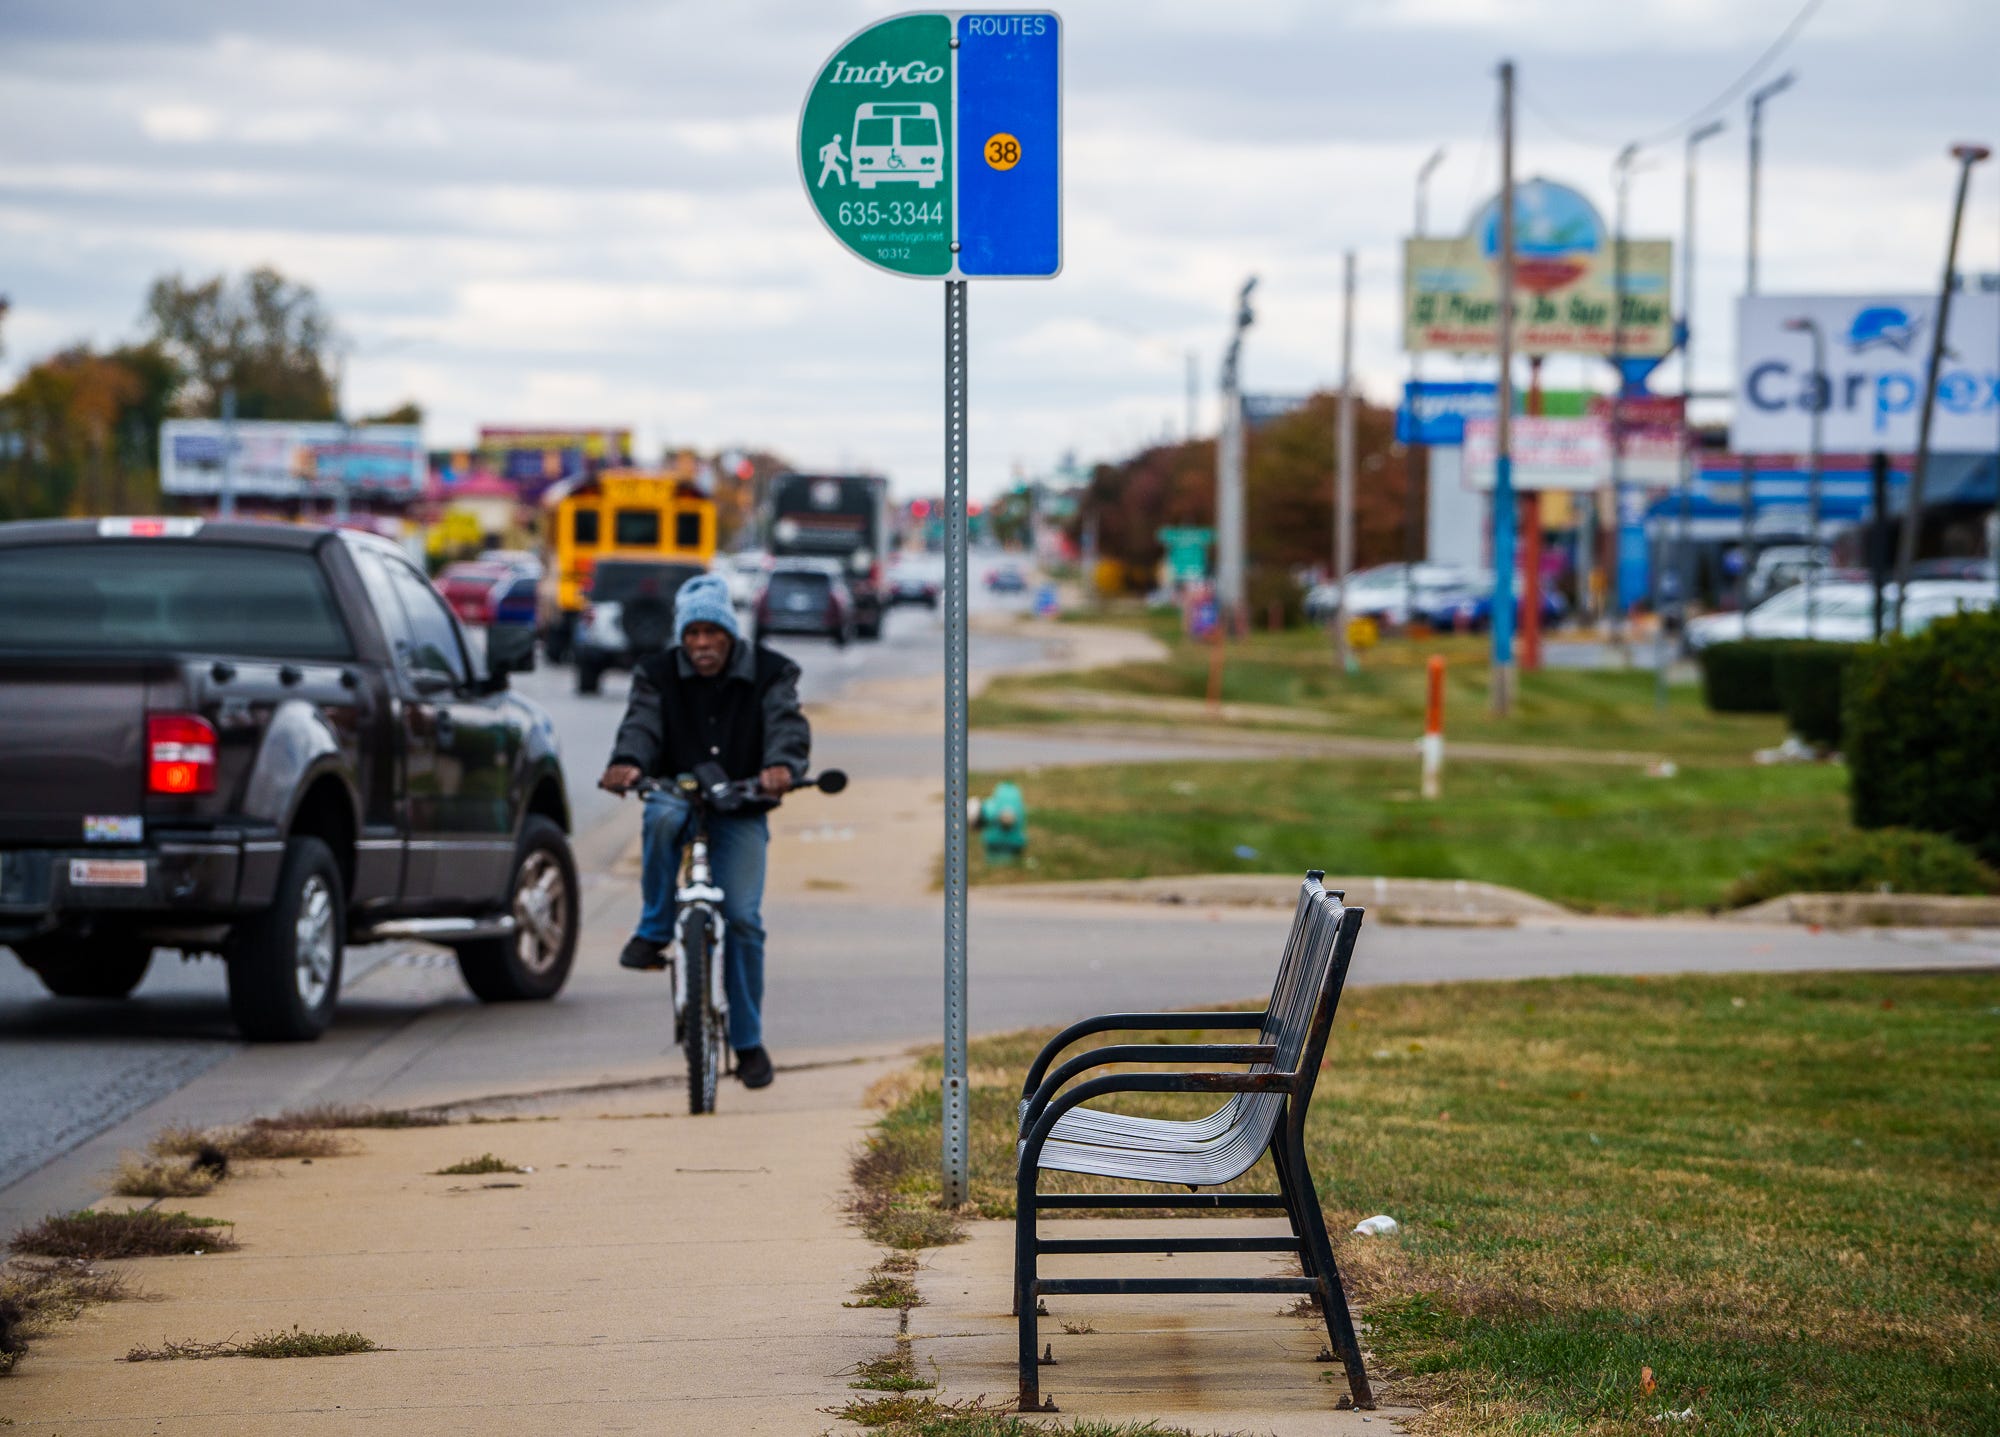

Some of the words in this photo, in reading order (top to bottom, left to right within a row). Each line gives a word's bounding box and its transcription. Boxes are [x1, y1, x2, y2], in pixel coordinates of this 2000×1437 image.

[969, 17, 1046, 36] ROUTES
[829, 60, 945, 88] IndyGo
[989, 141, 1018, 163] 38
[838, 201, 943, 226] 635-3344
[860, 231, 944, 244] www.indygo.net
[877, 248, 911, 260] 10312
[1745, 360, 2000, 434] Carpex
